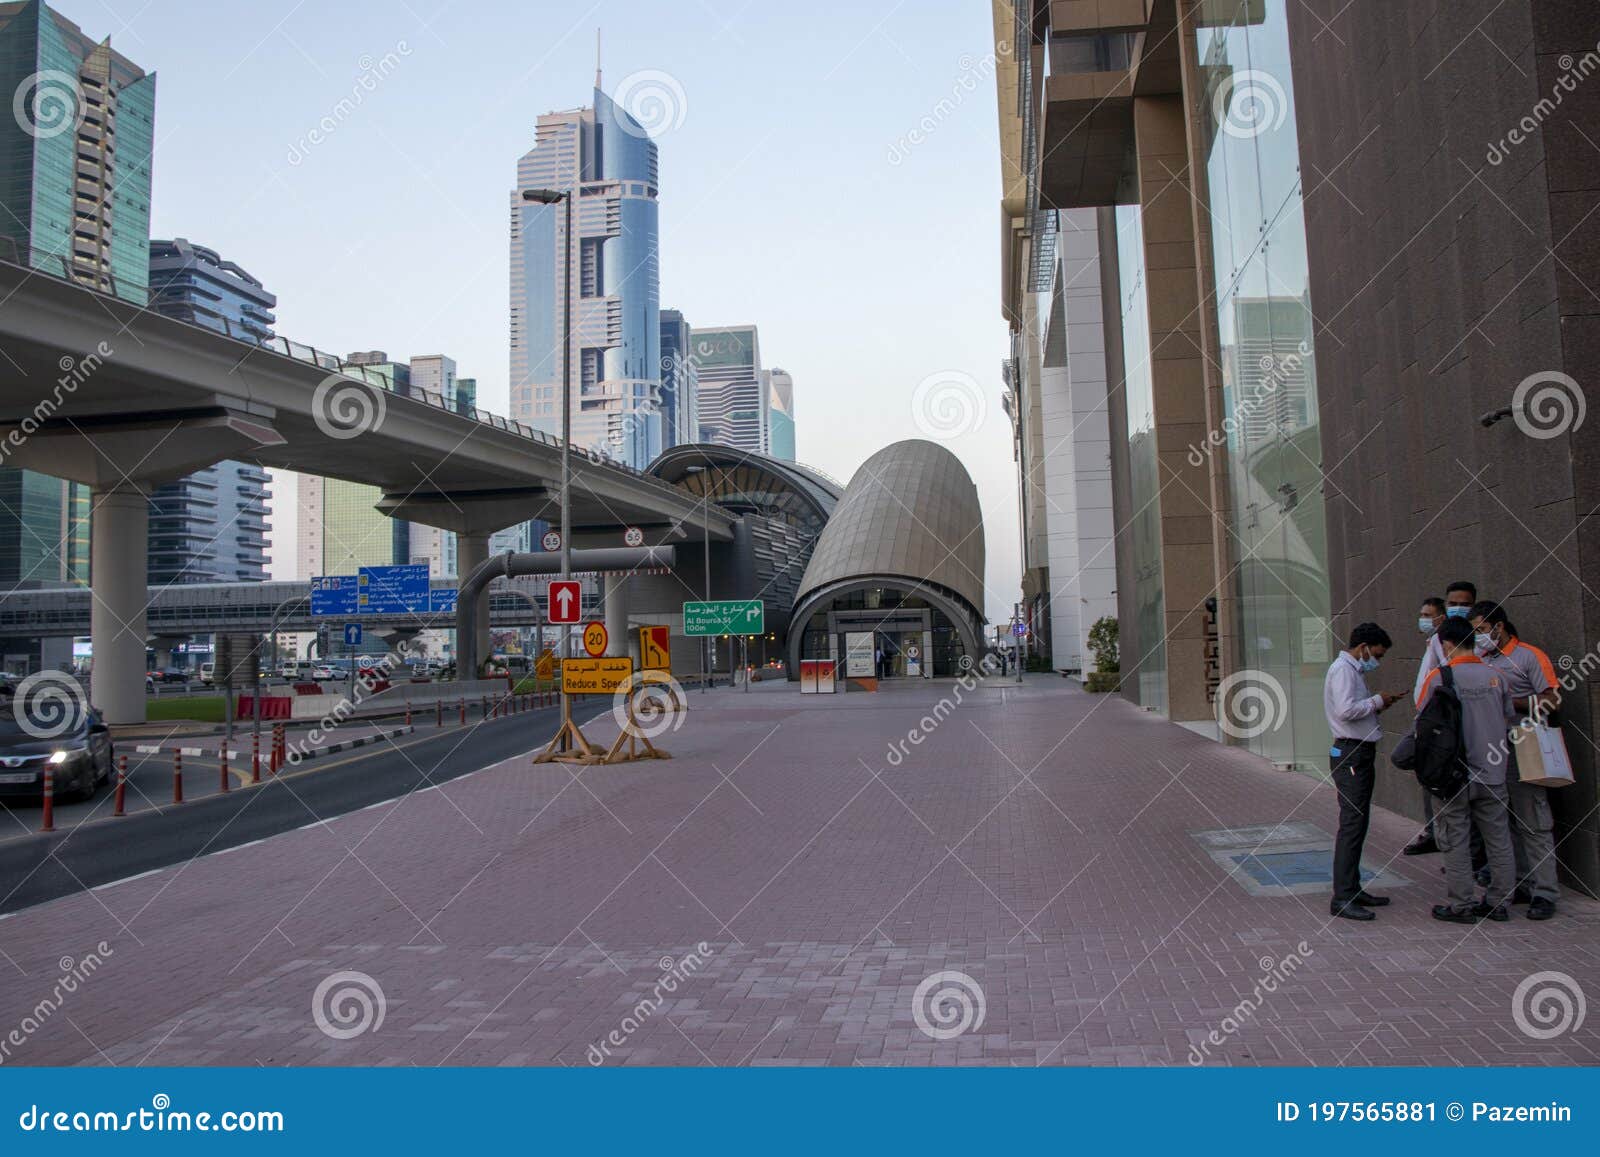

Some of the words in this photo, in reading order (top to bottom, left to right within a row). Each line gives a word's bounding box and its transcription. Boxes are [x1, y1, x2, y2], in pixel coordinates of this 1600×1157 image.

[589, 632, 602, 645] 20
[566, 678, 597, 689] Reduce
[601, 678, 629, 690] Speed
